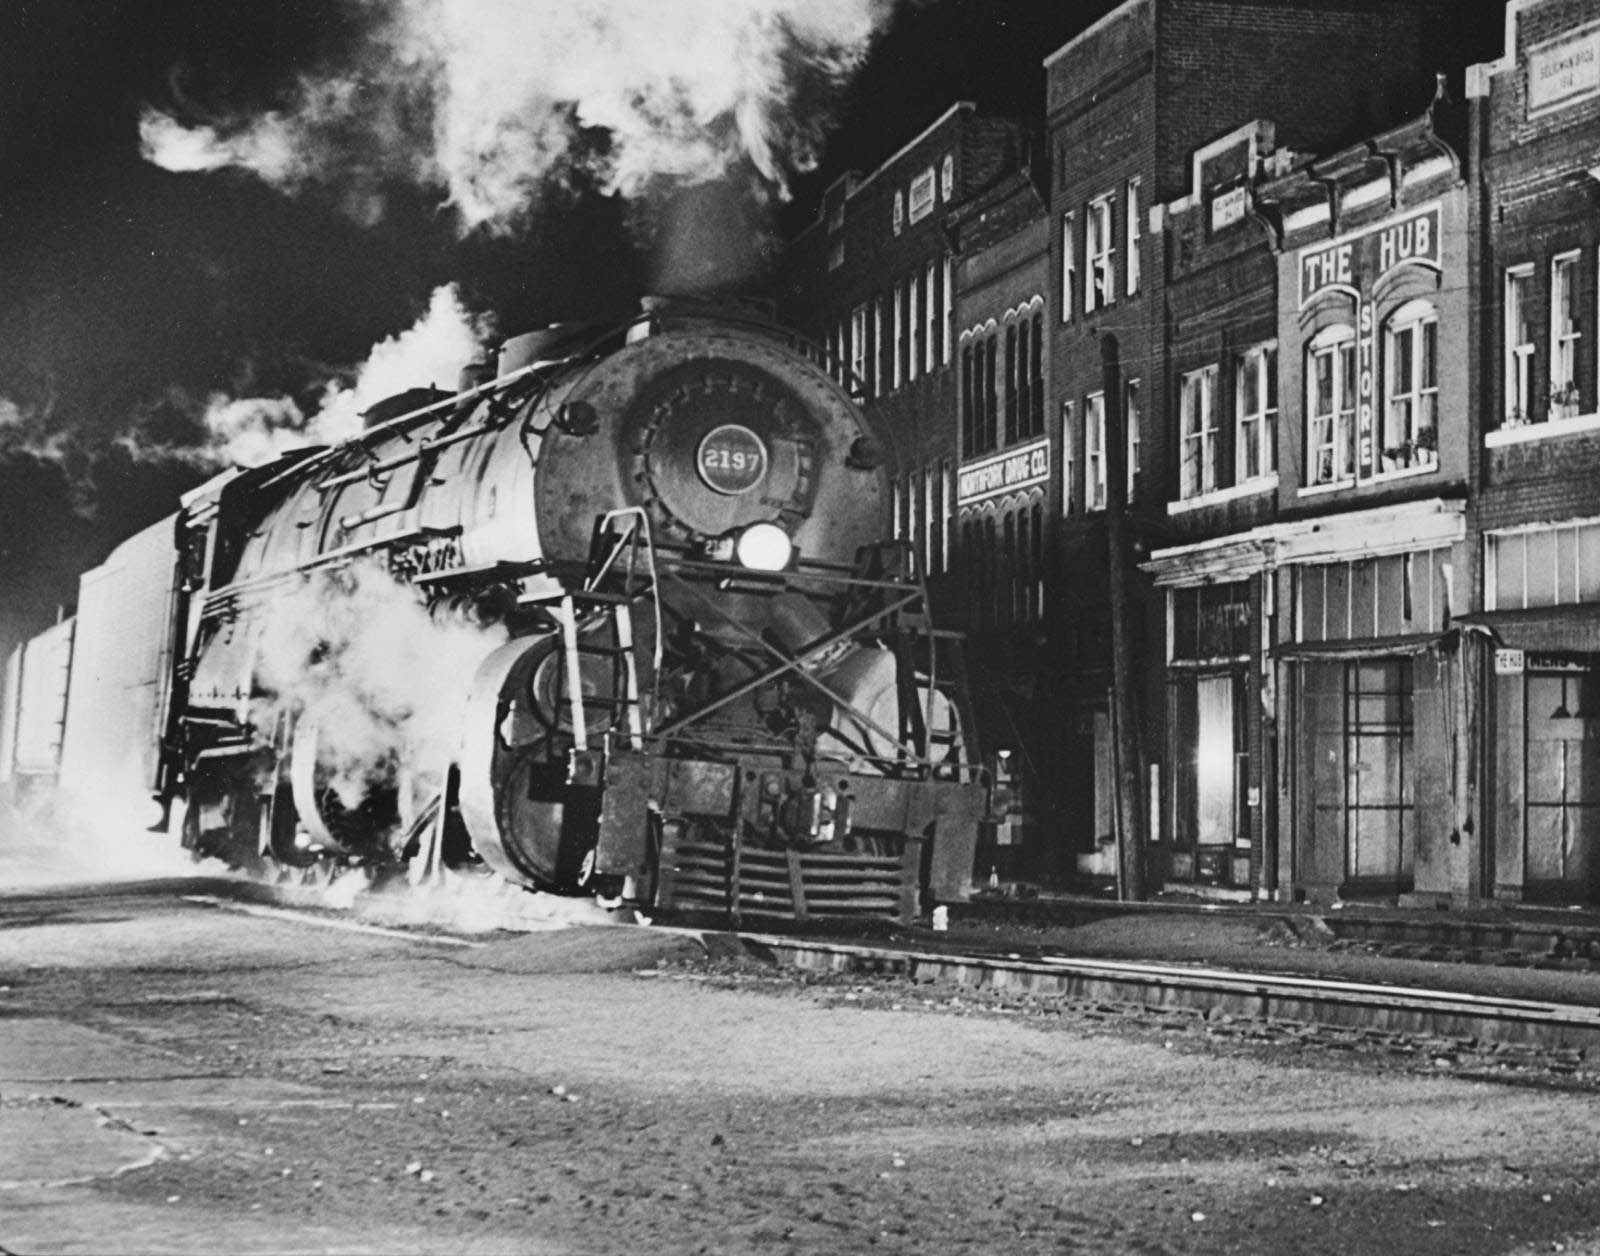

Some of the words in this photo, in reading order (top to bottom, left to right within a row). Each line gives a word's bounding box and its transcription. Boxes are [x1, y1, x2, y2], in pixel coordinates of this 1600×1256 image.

[1304, 244, 1353, 292] THE
[1379, 216, 1431, 273] HUB
[1360, 304, 1372, 465] STORE
[704, 448, 760, 473] 2197
[1031, 448, 1048, 476] CO.
